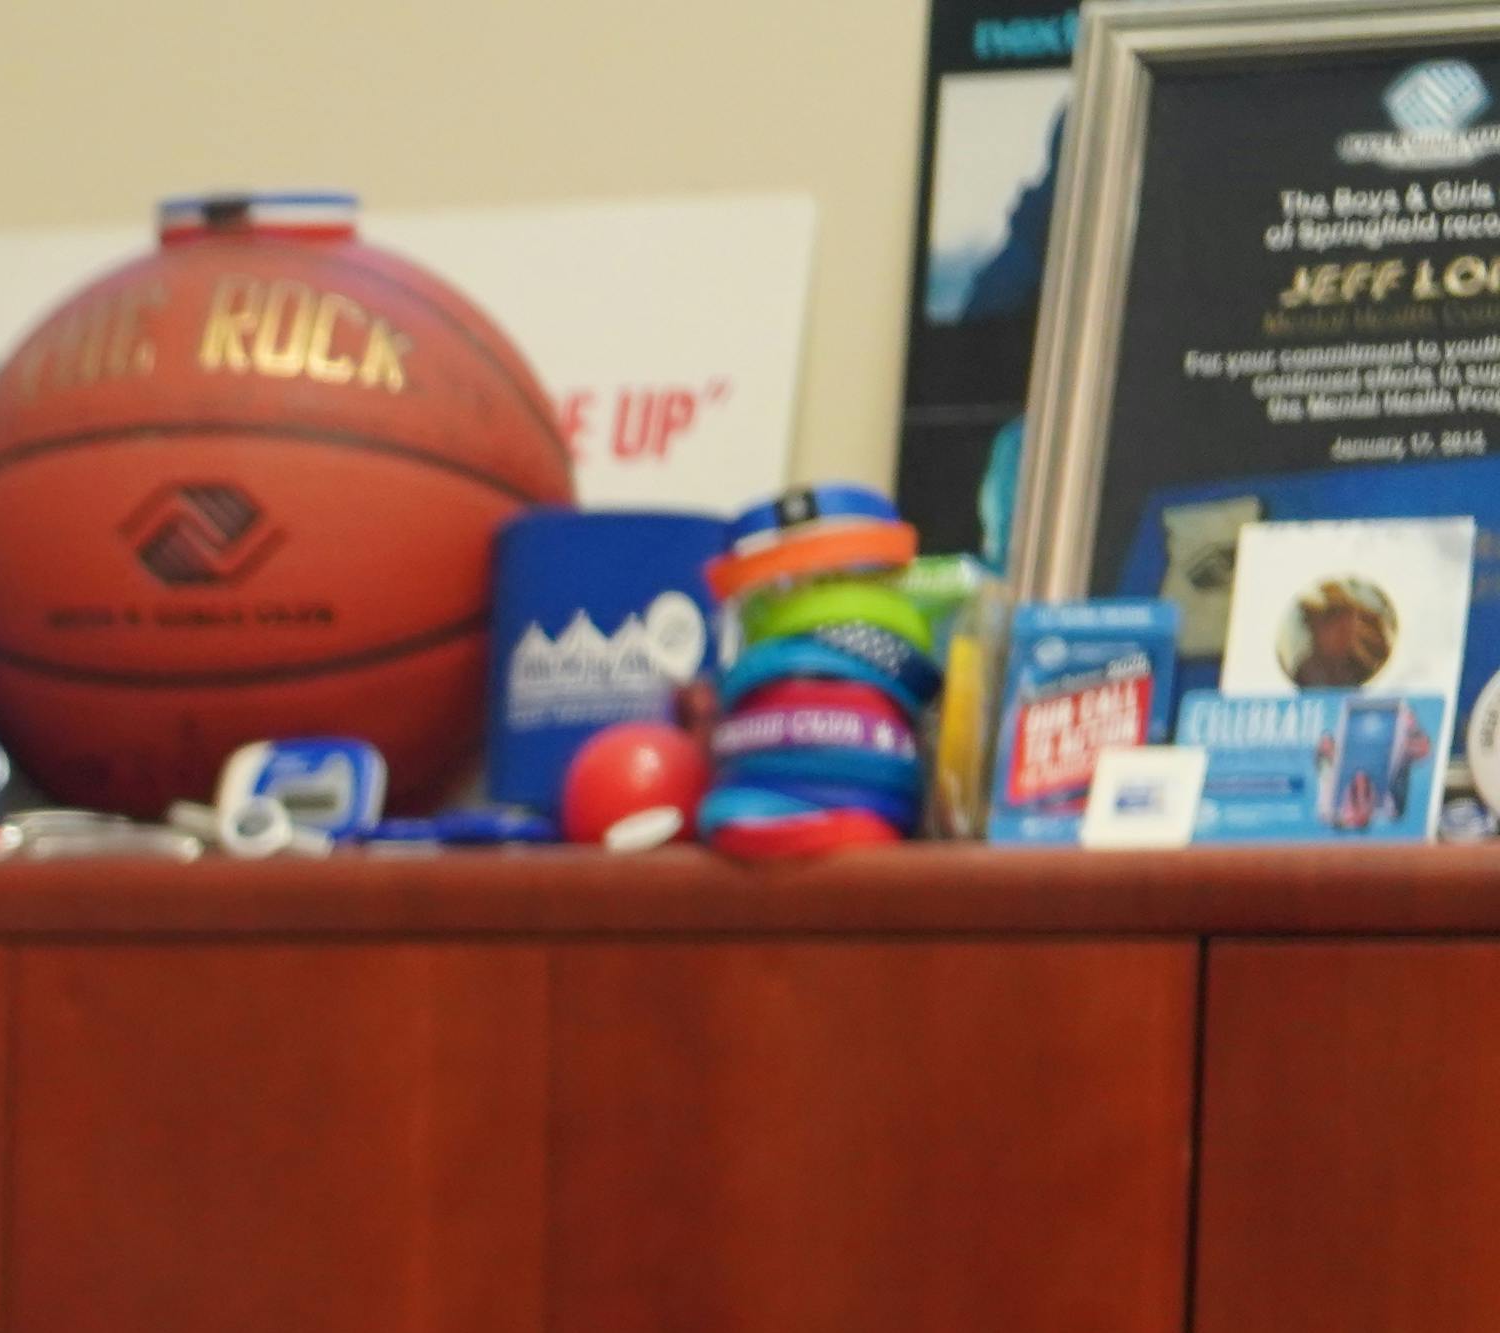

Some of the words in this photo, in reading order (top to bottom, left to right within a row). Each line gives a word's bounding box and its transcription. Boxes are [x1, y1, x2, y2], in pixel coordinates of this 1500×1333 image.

[1280, 190, 1330, 218] The
[1333, 187, 1400, 217] Boys
[1405, 182, 1426, 212] &
[1432, 179, 1495, 211] Girls
[1264, 217, 1295, 251] of
[1298, 212, 1439, 251] Springfield
[1280, 259, 1405, 308] JEFF
[199, 273, 412, 393] ROCK
